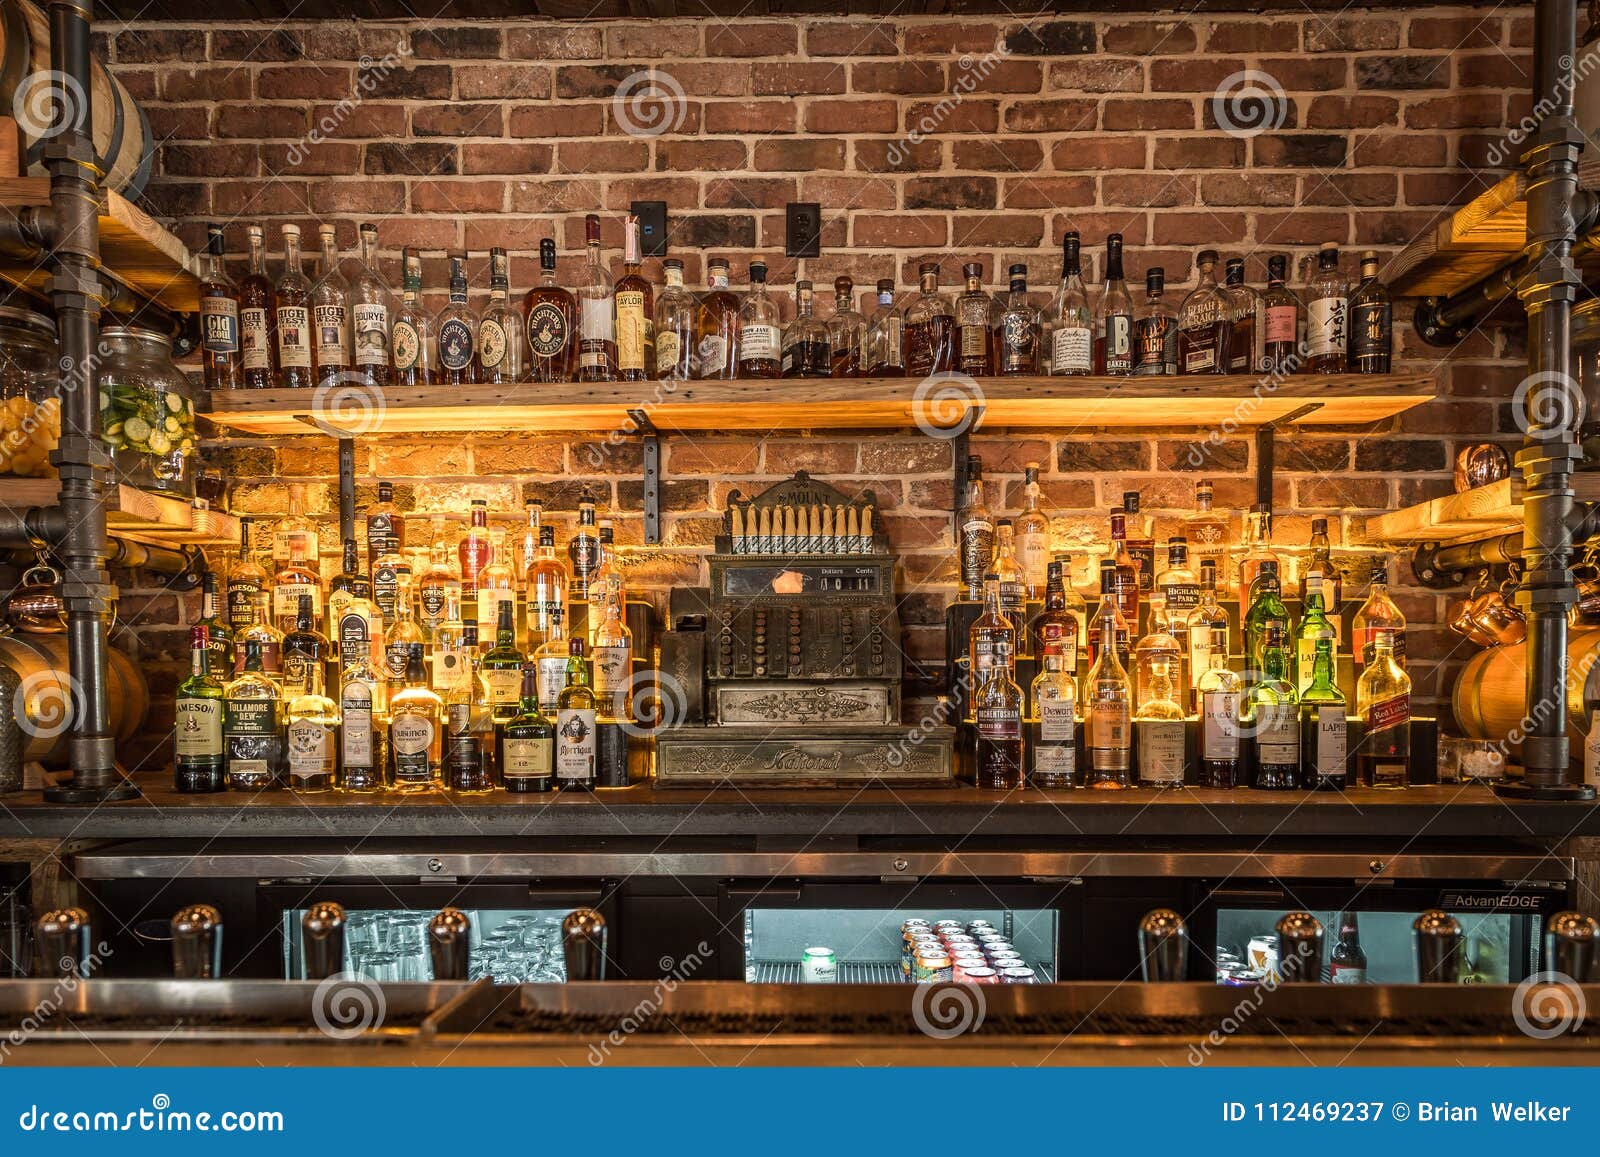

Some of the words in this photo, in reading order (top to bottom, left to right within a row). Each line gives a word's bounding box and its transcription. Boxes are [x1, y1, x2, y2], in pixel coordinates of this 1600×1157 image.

[316, 306, 344, 316] HIGH
[1114, 316, 1129, 355] B
[285, 659, 305, 667] TEELIN
[1455, 895, 1541, 907] AdvantEDGE
